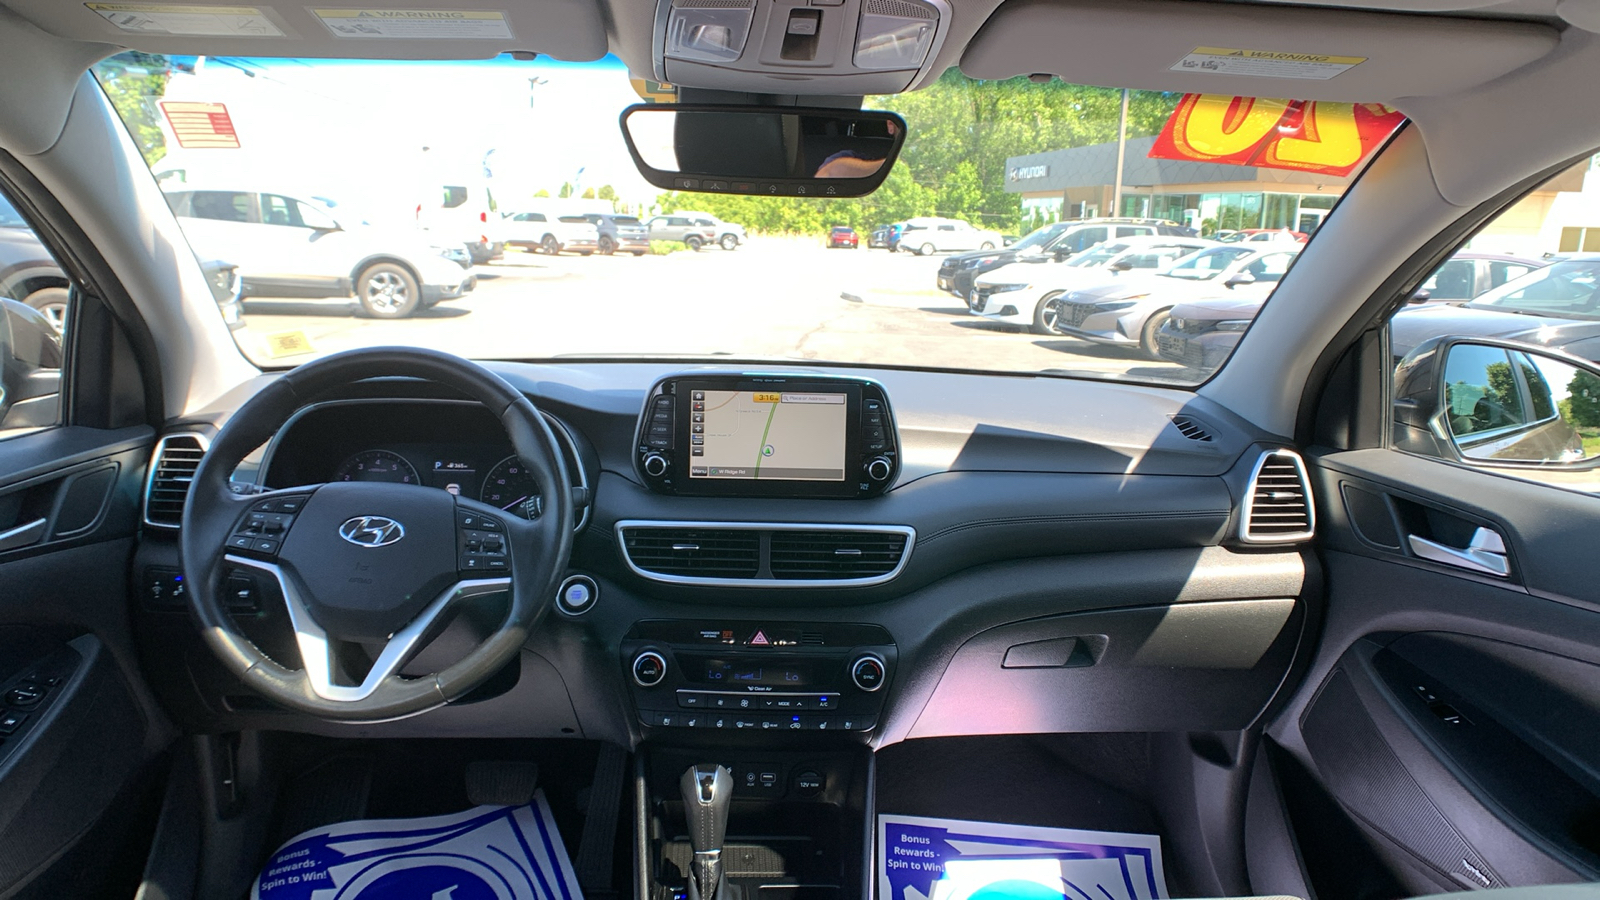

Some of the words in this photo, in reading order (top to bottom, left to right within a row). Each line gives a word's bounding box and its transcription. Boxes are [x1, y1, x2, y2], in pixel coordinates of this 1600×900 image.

[1250, 51, 1330, 62] WARNING
[1018, 165, 1047, 179] HYUNDAI
[435, 461, 442, 469] P
[901, 834, 930, 844] Bonus
[277, 848, 310, 863] Bonus
[894, 846, 935, 858] Rewards
[269, 859, 316, 877] Rewards
[887, 859, 908, 870] Spin
[911, 861, 921, 870] to
[922, 862, 944, 871] Win!
[261, 878, 286, 891] Spin
[288, 876, 300, 884] to
[302, 870, 327, 882] Win!
